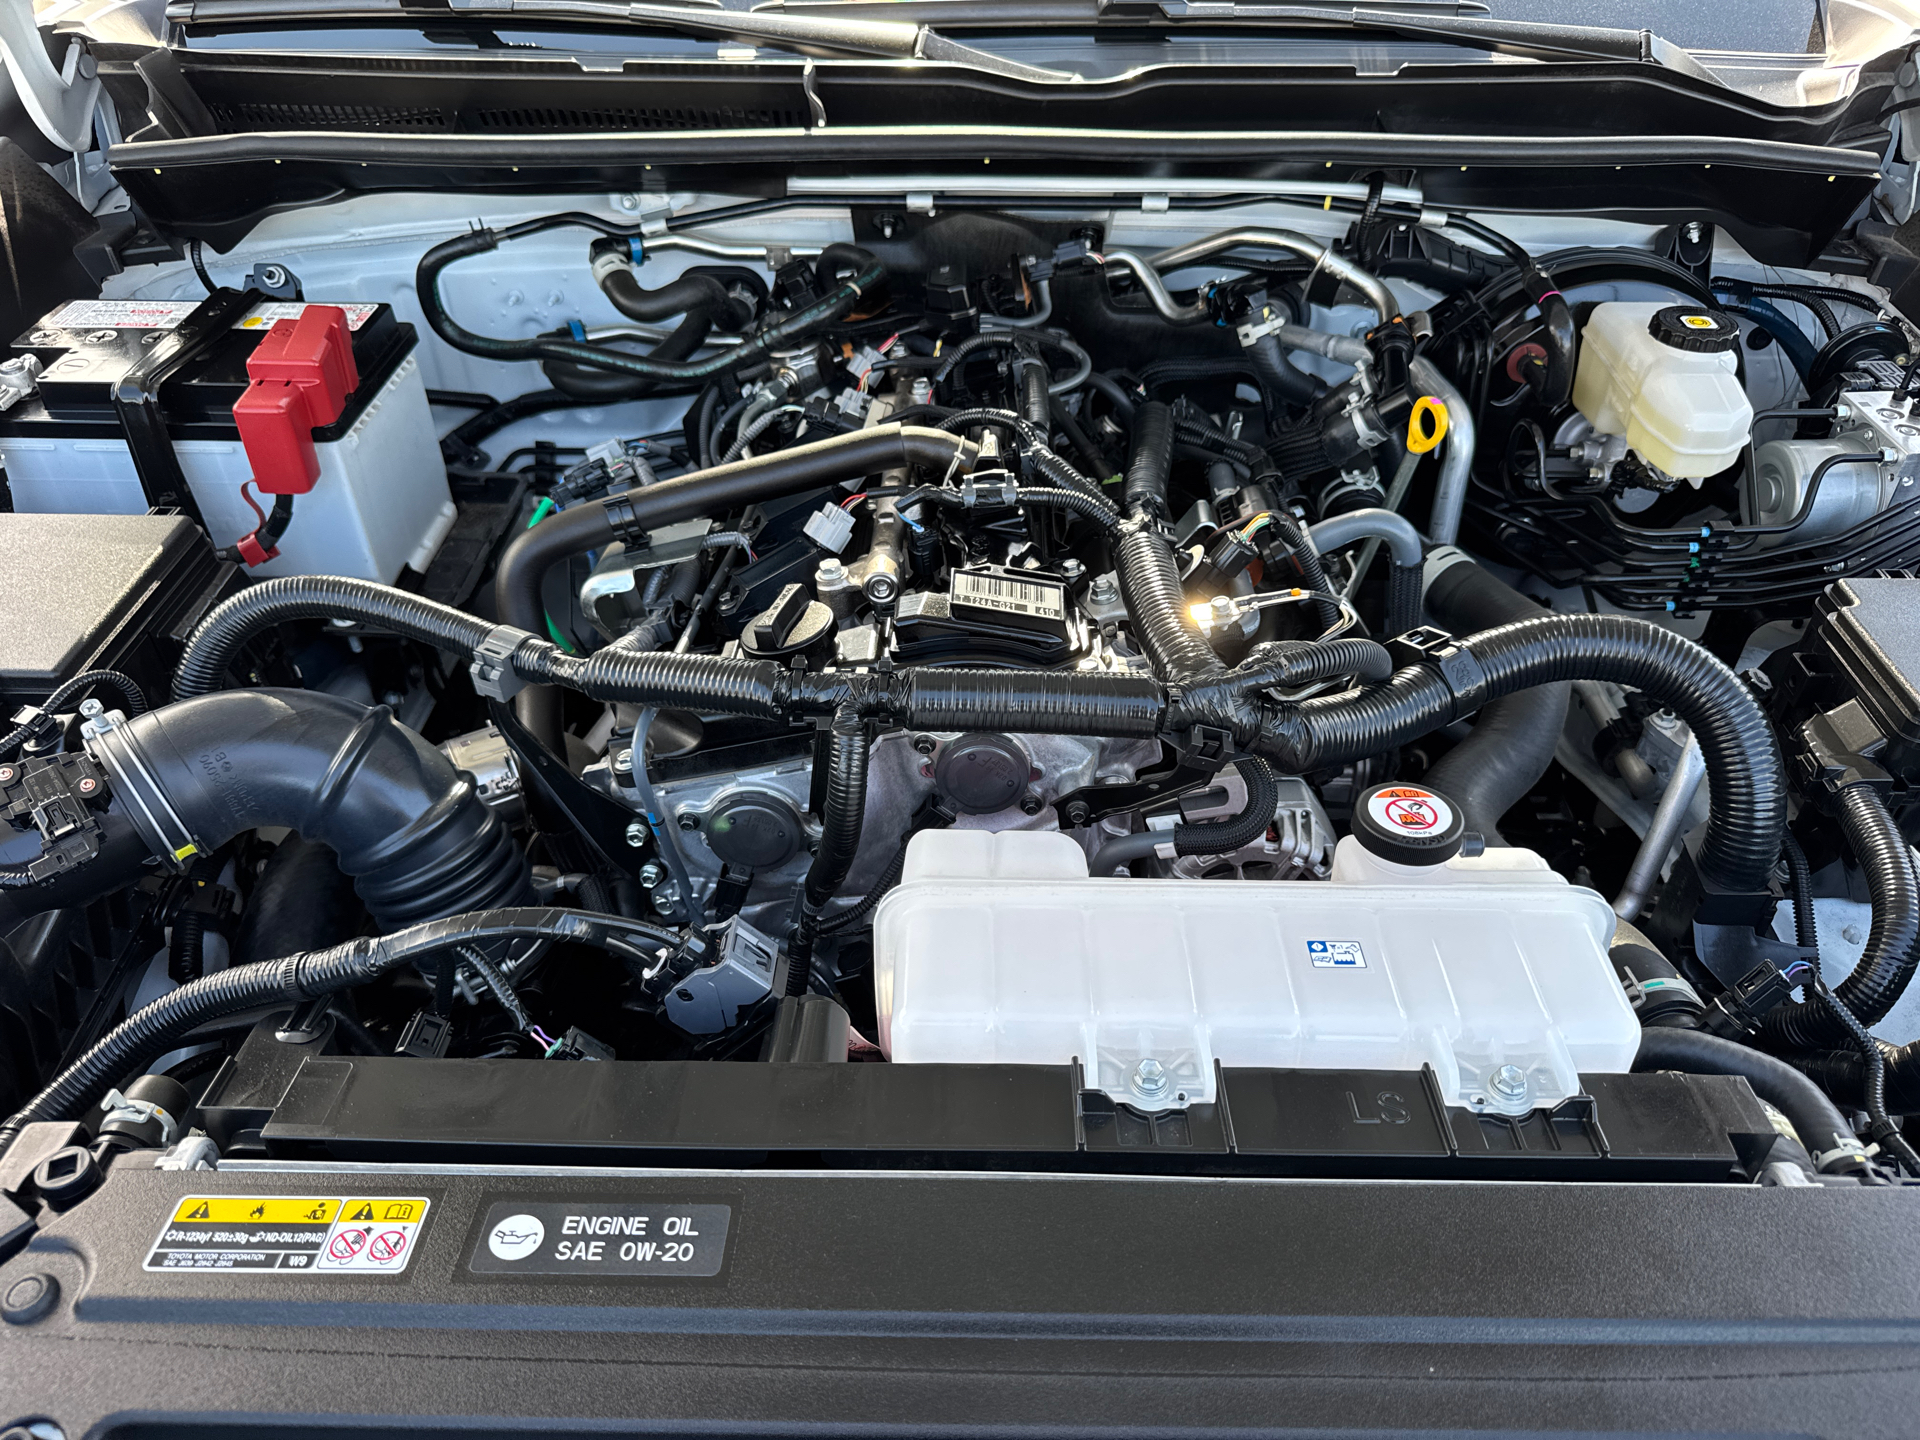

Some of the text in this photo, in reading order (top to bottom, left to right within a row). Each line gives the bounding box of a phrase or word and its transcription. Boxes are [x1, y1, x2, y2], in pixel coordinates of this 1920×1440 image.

[970, 596, 1016, 611] T24A-G21
[1038, 607, 1055, 617] 410
[1345, 1090, 1412, 1125] LS
[561, 1215, 700, 1236] ENGINE OIL
[167, 1252, 266, 1262] TOYOTA MOTOR CORPORATION
[554, 1241, 695, 1262] SAE 0W-20
[163, 1259, 178, 1267] SAE
[288, 1255, 308, 1267] W9
